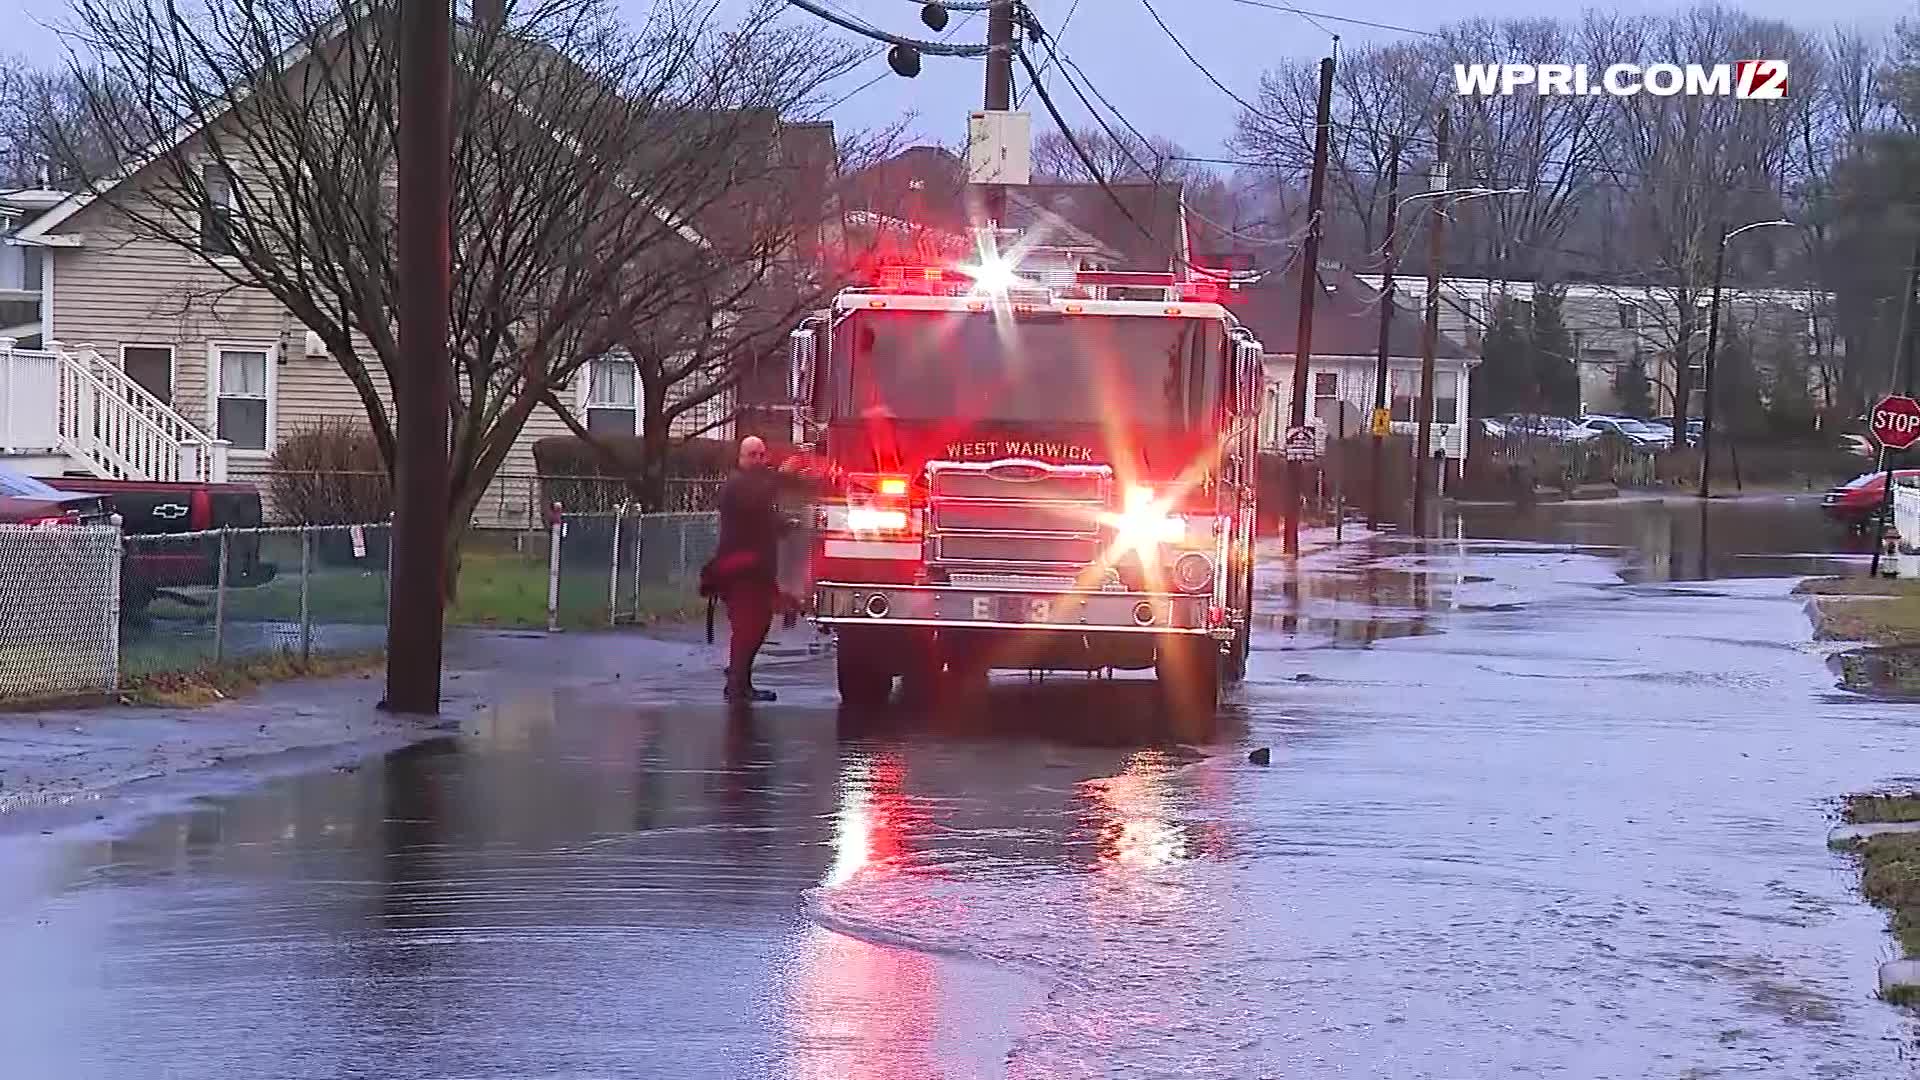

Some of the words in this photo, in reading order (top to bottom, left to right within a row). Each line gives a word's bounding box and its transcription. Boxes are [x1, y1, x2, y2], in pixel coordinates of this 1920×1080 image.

[1874, 410, 1920, 433] STOP
[946, 441, 999, 458] WEST
[1005, 441, 1093, 461] WARWICK
